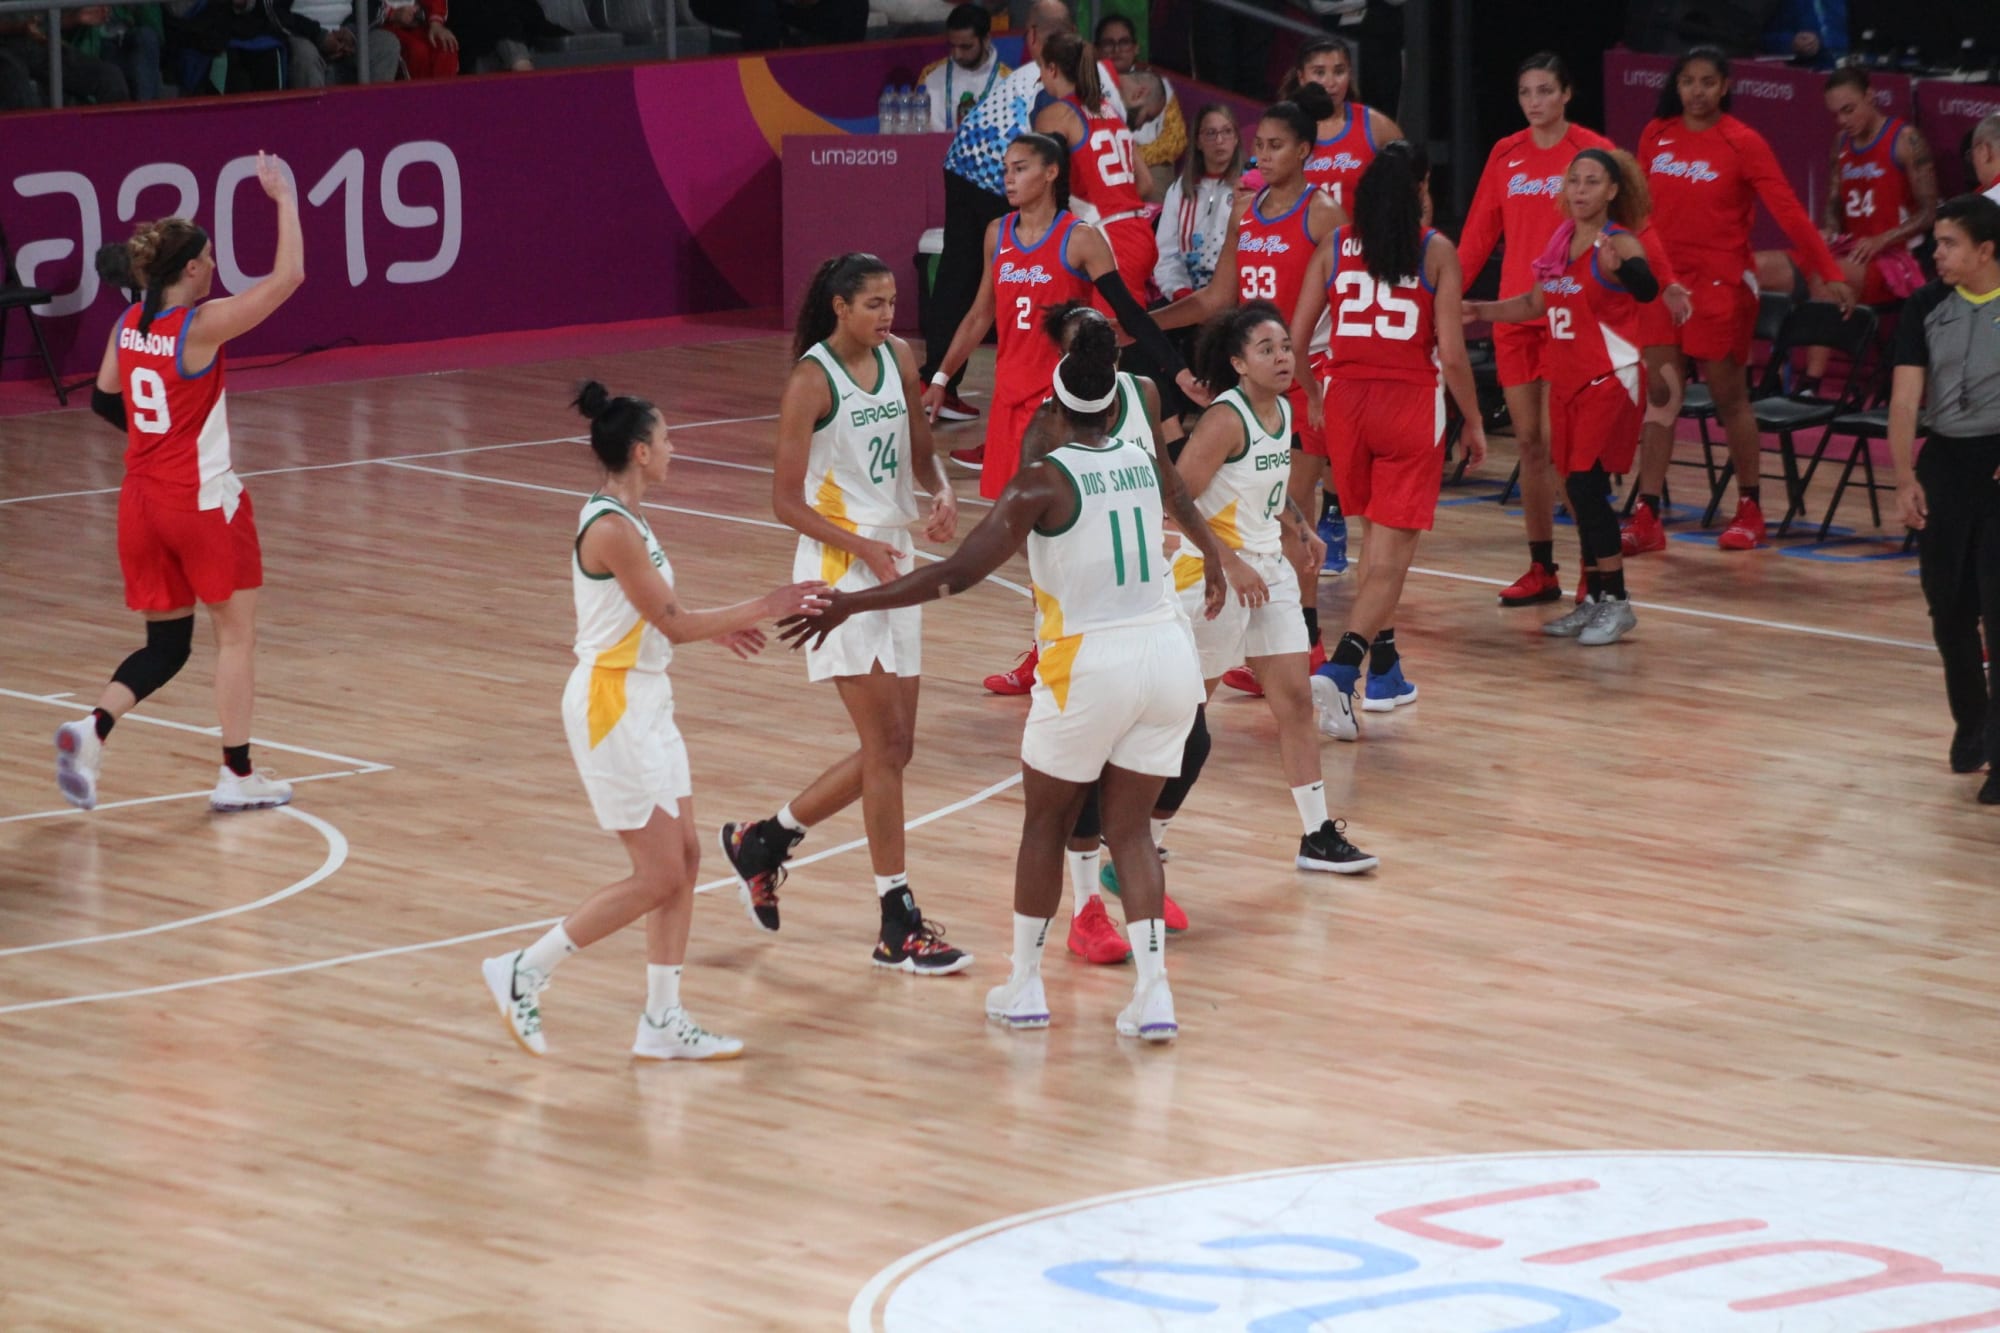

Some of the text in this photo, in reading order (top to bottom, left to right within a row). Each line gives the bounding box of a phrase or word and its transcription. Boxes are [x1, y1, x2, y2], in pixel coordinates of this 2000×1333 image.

[1090, 129, 1134, 186] 20
[1331, 152, 1362, 173] Rico
[1650, 152, 1719, 184] Puerto Rico
[1507, 172, 1543, 198] Puerto
[1846, 187, 1876, 217] 24
[1261, 235, 1290, 256] Rico
[999, 262, 1052, 287] Puerto Rico
[1241, 266, 1276, 299] 33
[1016, 296, 1031, 330] 2
[1334, 270, 1420, 341] 25
[1547, 305, 1575, 339] 12
[120, 327, 176, 357] GIBSON
[130, 366, 172, 434] 9
[851, 400, 907, 428] BRASIL
[868, 432, 898, 484] 24
[1255, 449, 1290, 471] BRAS
[1081, 465, 1155, 496] DOS SANTOS
[1109, 506, 1150, 586] 11
